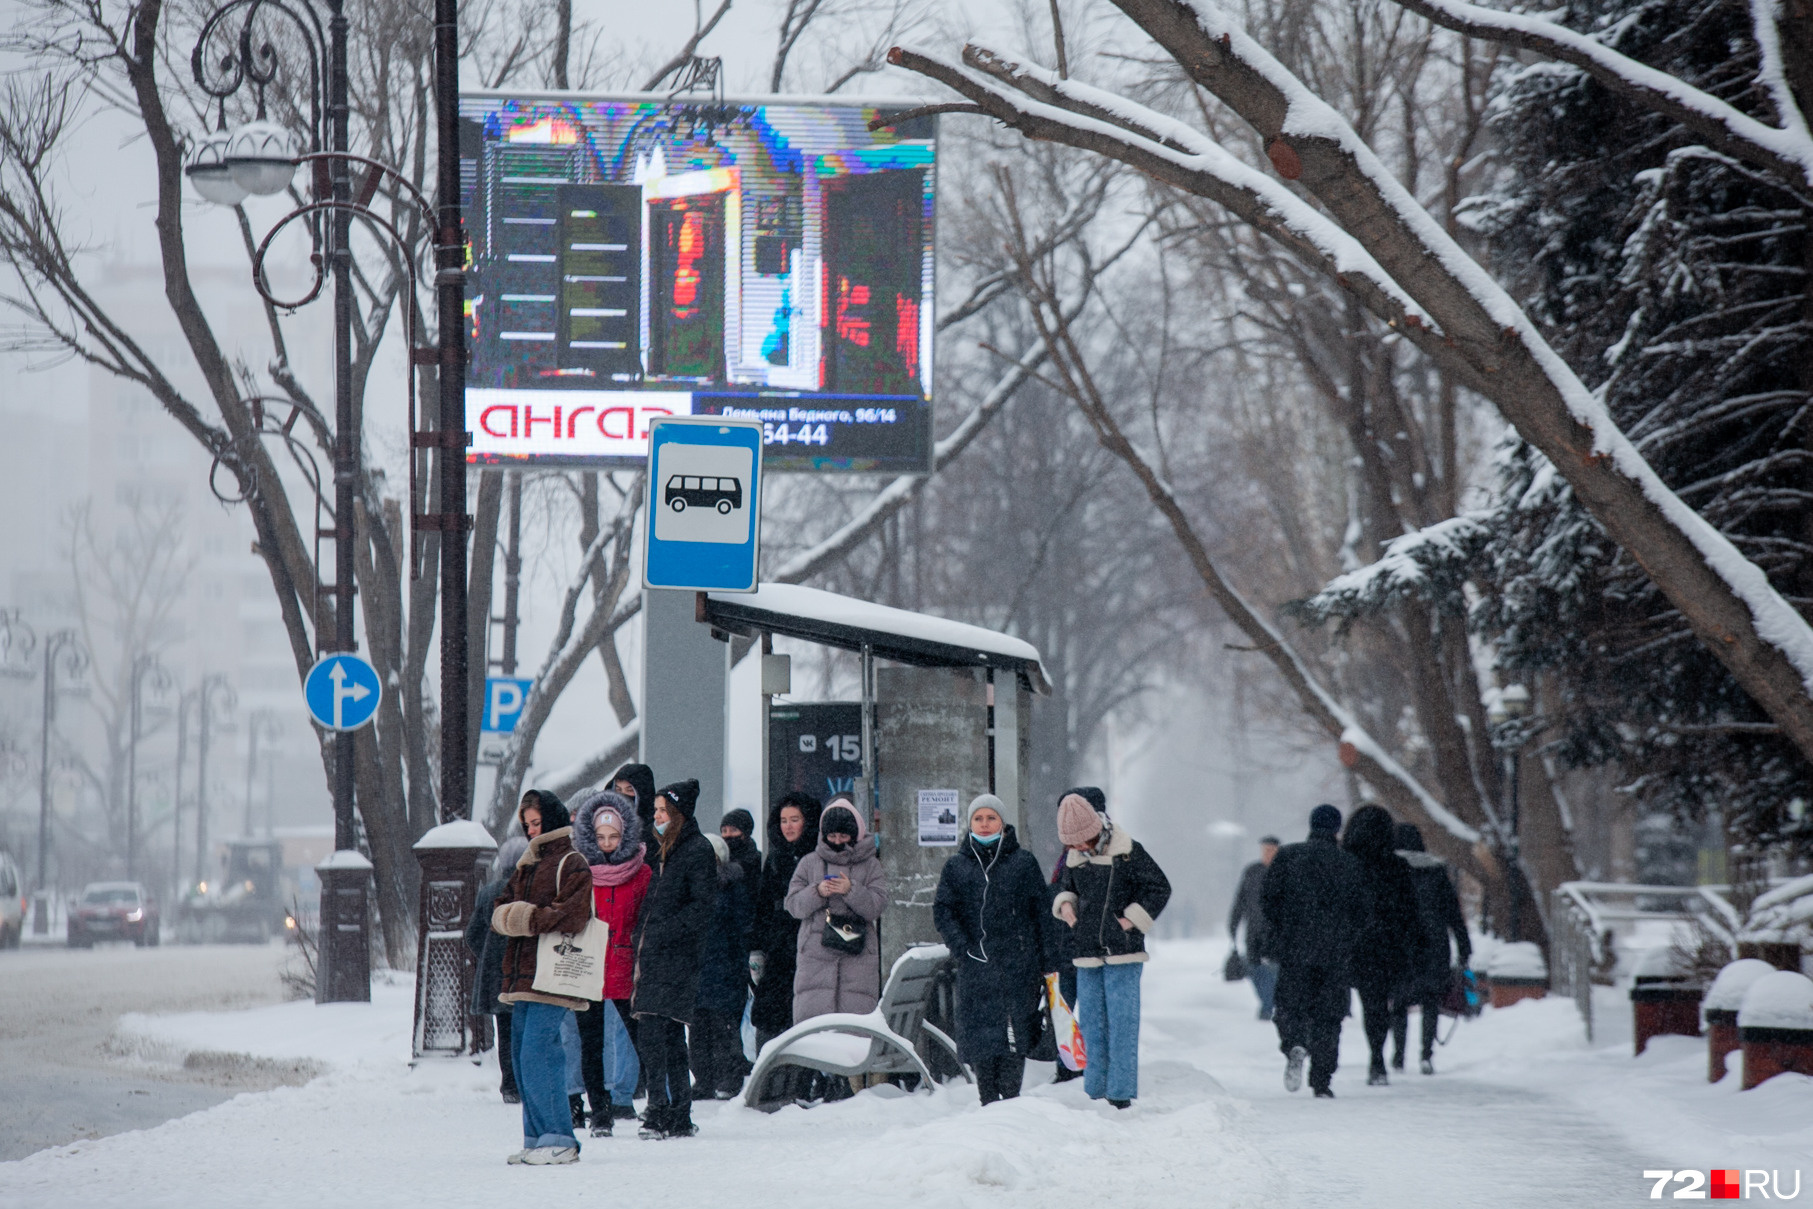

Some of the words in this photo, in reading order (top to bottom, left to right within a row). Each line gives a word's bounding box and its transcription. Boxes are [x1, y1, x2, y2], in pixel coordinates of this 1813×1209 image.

[855, 408, 896, 423] 96/14
[489, 682, 523, 729] P
[825, 734, 860, 761] 15
